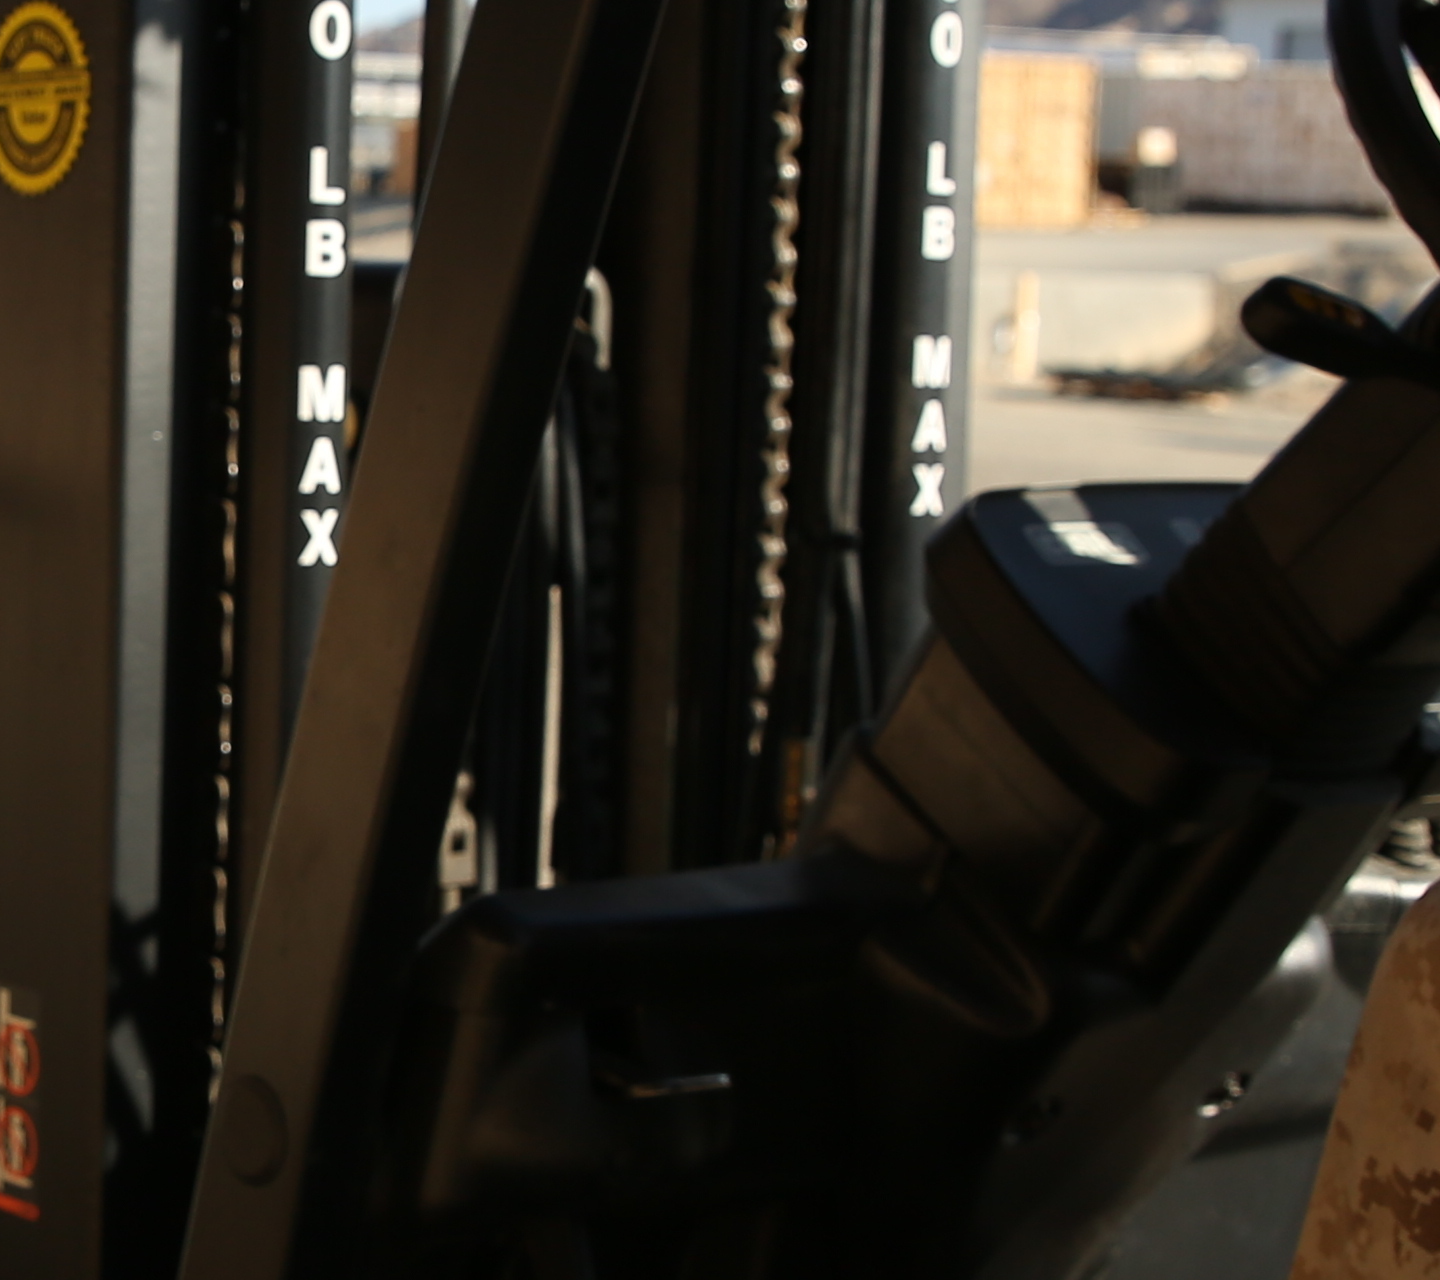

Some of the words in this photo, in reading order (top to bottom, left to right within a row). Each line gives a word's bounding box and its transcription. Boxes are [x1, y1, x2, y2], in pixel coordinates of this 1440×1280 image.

[305, 146, 347, 278] LB
[921, 140, 957, 261] LB
[297, 363, 347, 567] MAX
[909, 334, 952, 517] MAX
